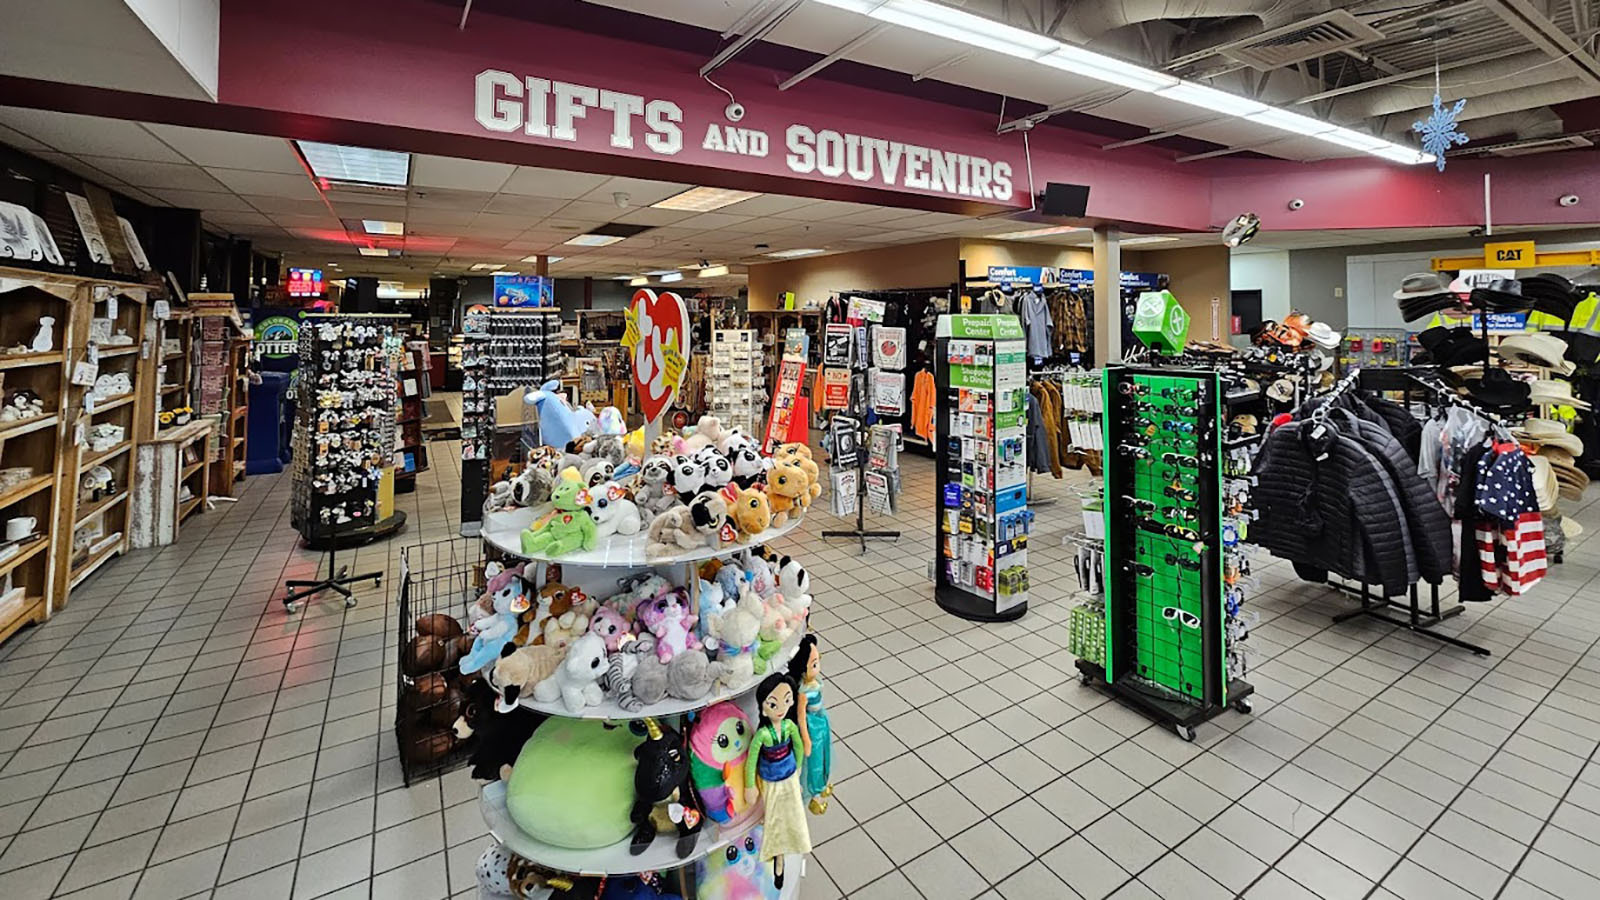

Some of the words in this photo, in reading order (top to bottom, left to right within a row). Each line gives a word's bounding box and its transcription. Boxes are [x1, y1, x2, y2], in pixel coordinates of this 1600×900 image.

[474, 68, 683, 155] GIFTS
[702, 123, 769, 158] AND
[785, 124, 1013, 201] SOUVENIRS
[1496, 249, 1523, 261] CAT
[989, 267, 1017, 276] Comfort
[1060, 270, 1083, 279] Comfort
[965, 327, 991, 336] Center
[255, 343, 299, 354] OTTER
[962, 367, 992, 379] Shopping
[969, 375, 992, 386] Dining
